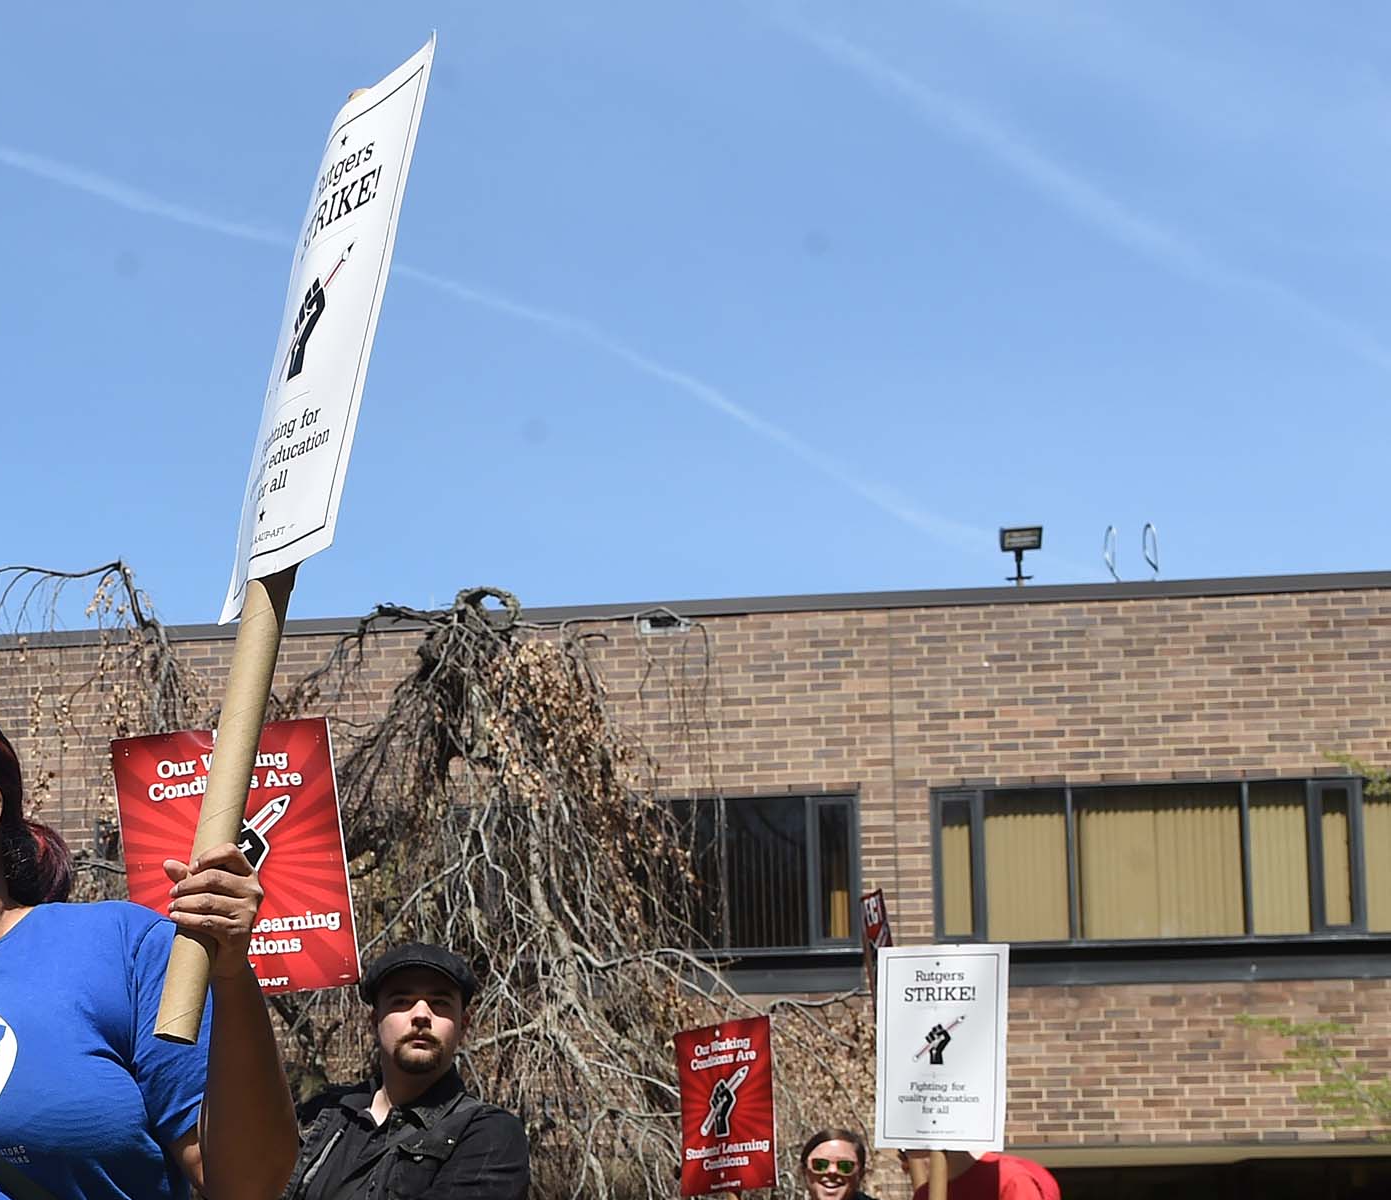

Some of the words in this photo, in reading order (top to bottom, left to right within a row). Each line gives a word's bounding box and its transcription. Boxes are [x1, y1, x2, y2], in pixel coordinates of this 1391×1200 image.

[300, 408, 321, 429] for
[269, 429, 330, 469] education
[270, 469, 288, 493] all
[157, 760, 196, 778] Our
[148, 775, 258, 801] Condis
[264, 770, 302, 787] Are
[916, 970, 964, 984] Rutgers
[905, 987, 976, 1002] STRIKE!
[736, 1050, 756, 1061] Are
[910, 1082, 947, 1093] Fighting
[951, 1082, 965, 1091] for
[898, 1094, 927, 1104] quality
[930, 1094, 979, 1103] education
[922, 1106, 933, 1114] for
[937, 1106, 949, 1114] all
